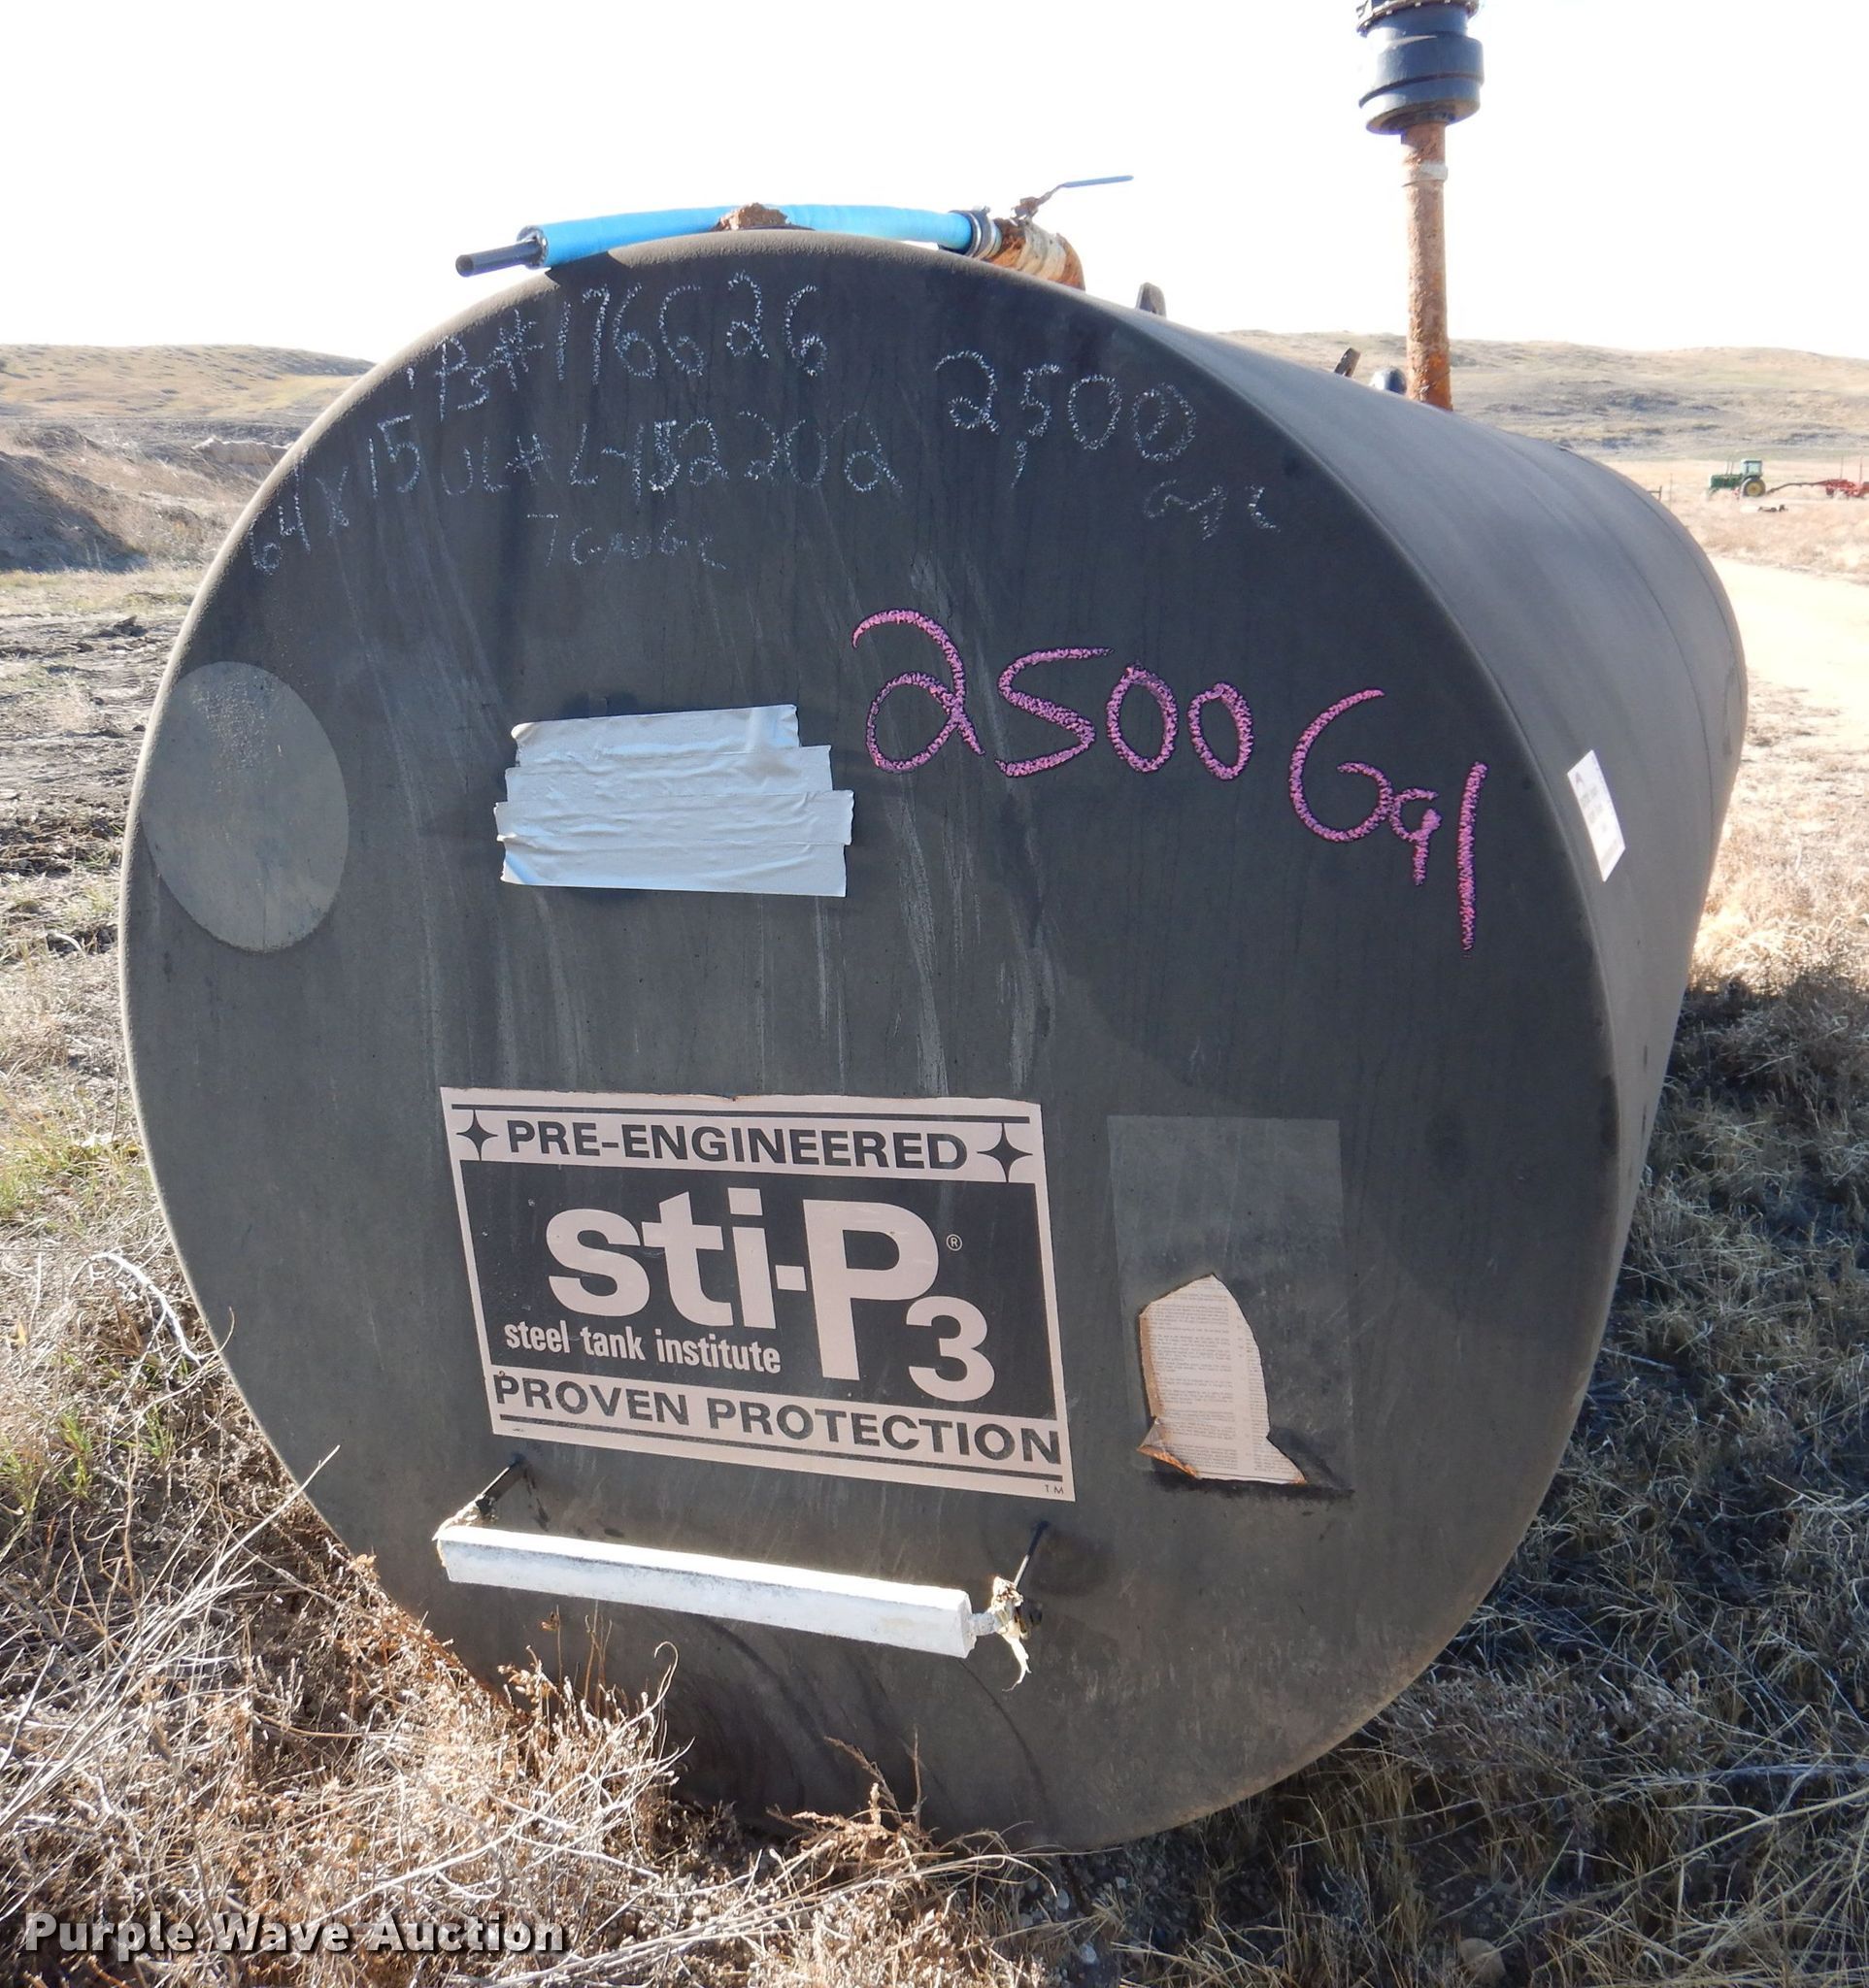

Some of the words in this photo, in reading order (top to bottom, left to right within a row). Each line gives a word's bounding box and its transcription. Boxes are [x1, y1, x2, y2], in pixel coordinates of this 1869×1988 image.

[851, 608, 1254, 780] 2500
[506, 1118, 969, 1170] PRE-ENGINEERED
[504, 1320, 571, 1353] steel
[581, 1326, 646, 1360] tank
[654, 1328, 782, 1374] institute
[493, 1374, 689, 1426] PROVEN
[707, 1397, 1062, 1465] PROTECTION
